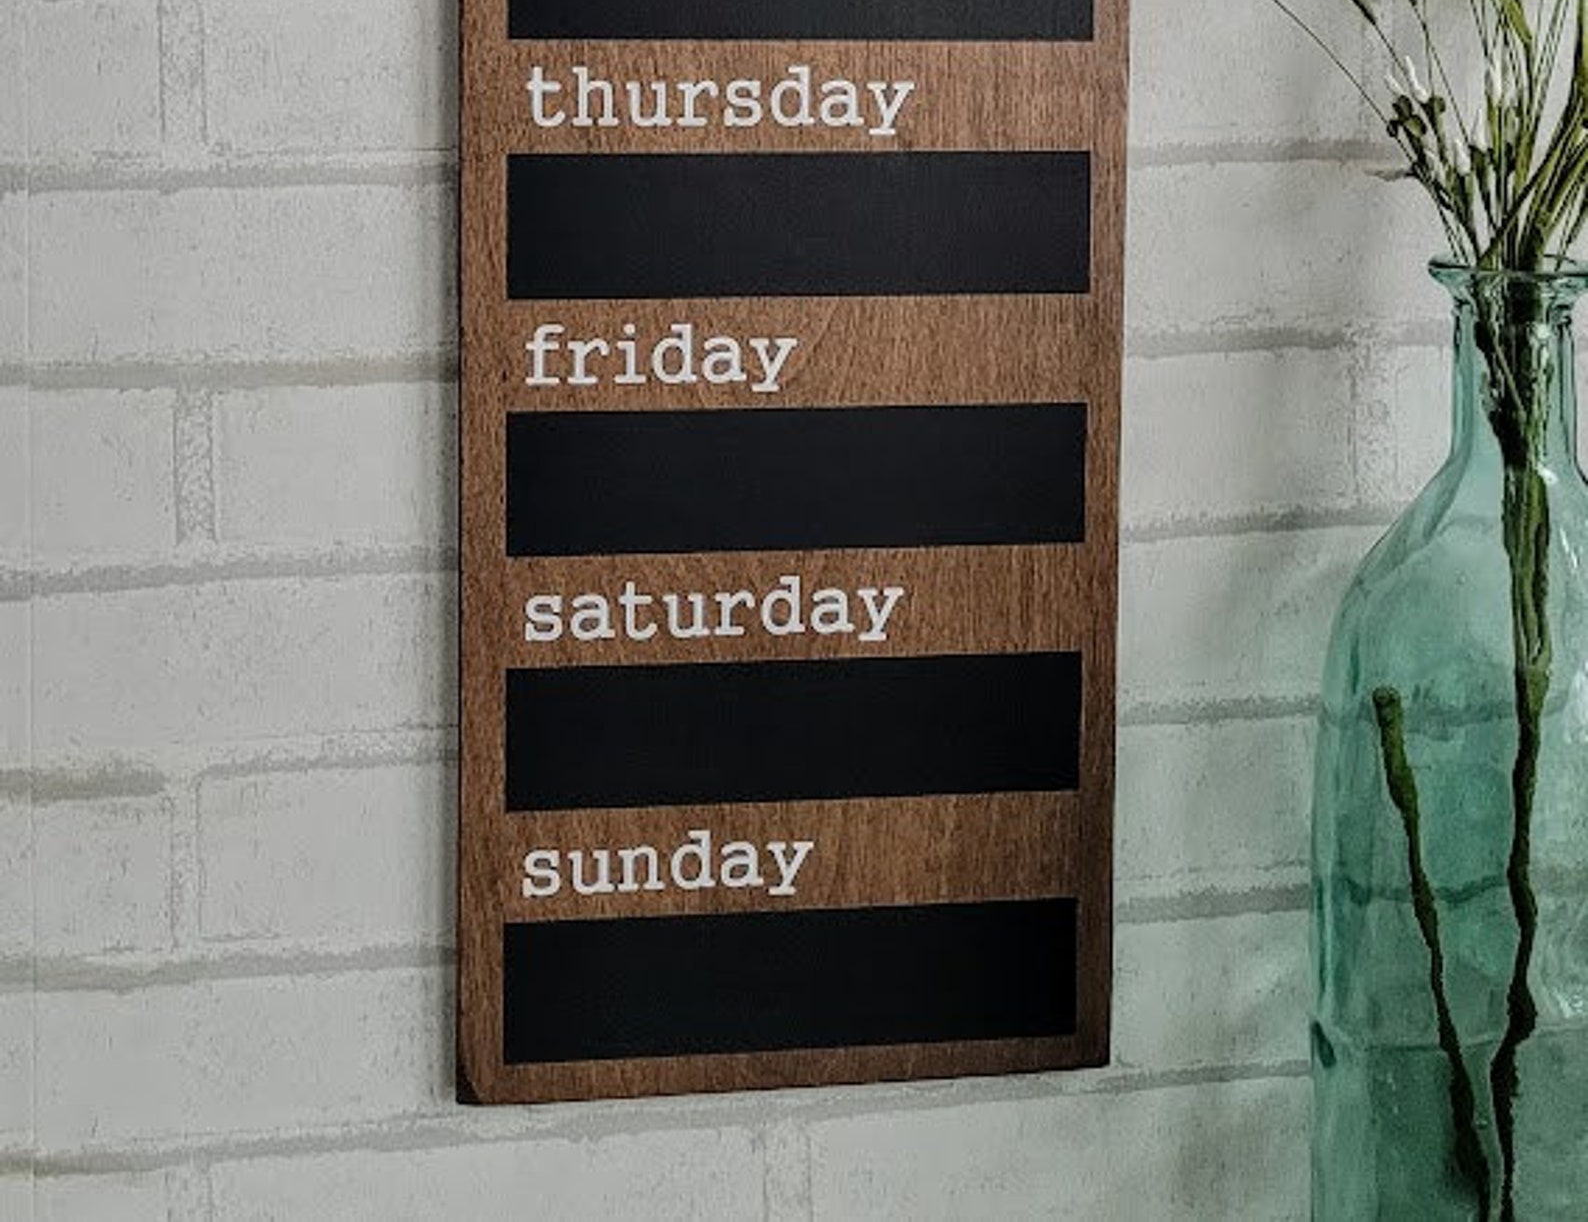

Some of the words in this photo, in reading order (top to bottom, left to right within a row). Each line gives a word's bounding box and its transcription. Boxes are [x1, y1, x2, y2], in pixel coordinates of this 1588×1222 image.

[527, 65, 915, 136] thursday
[526, 324, 798, 391] friday
[525, 576, 904, 642] saturday
[523, 831, 814, 897] sunday
